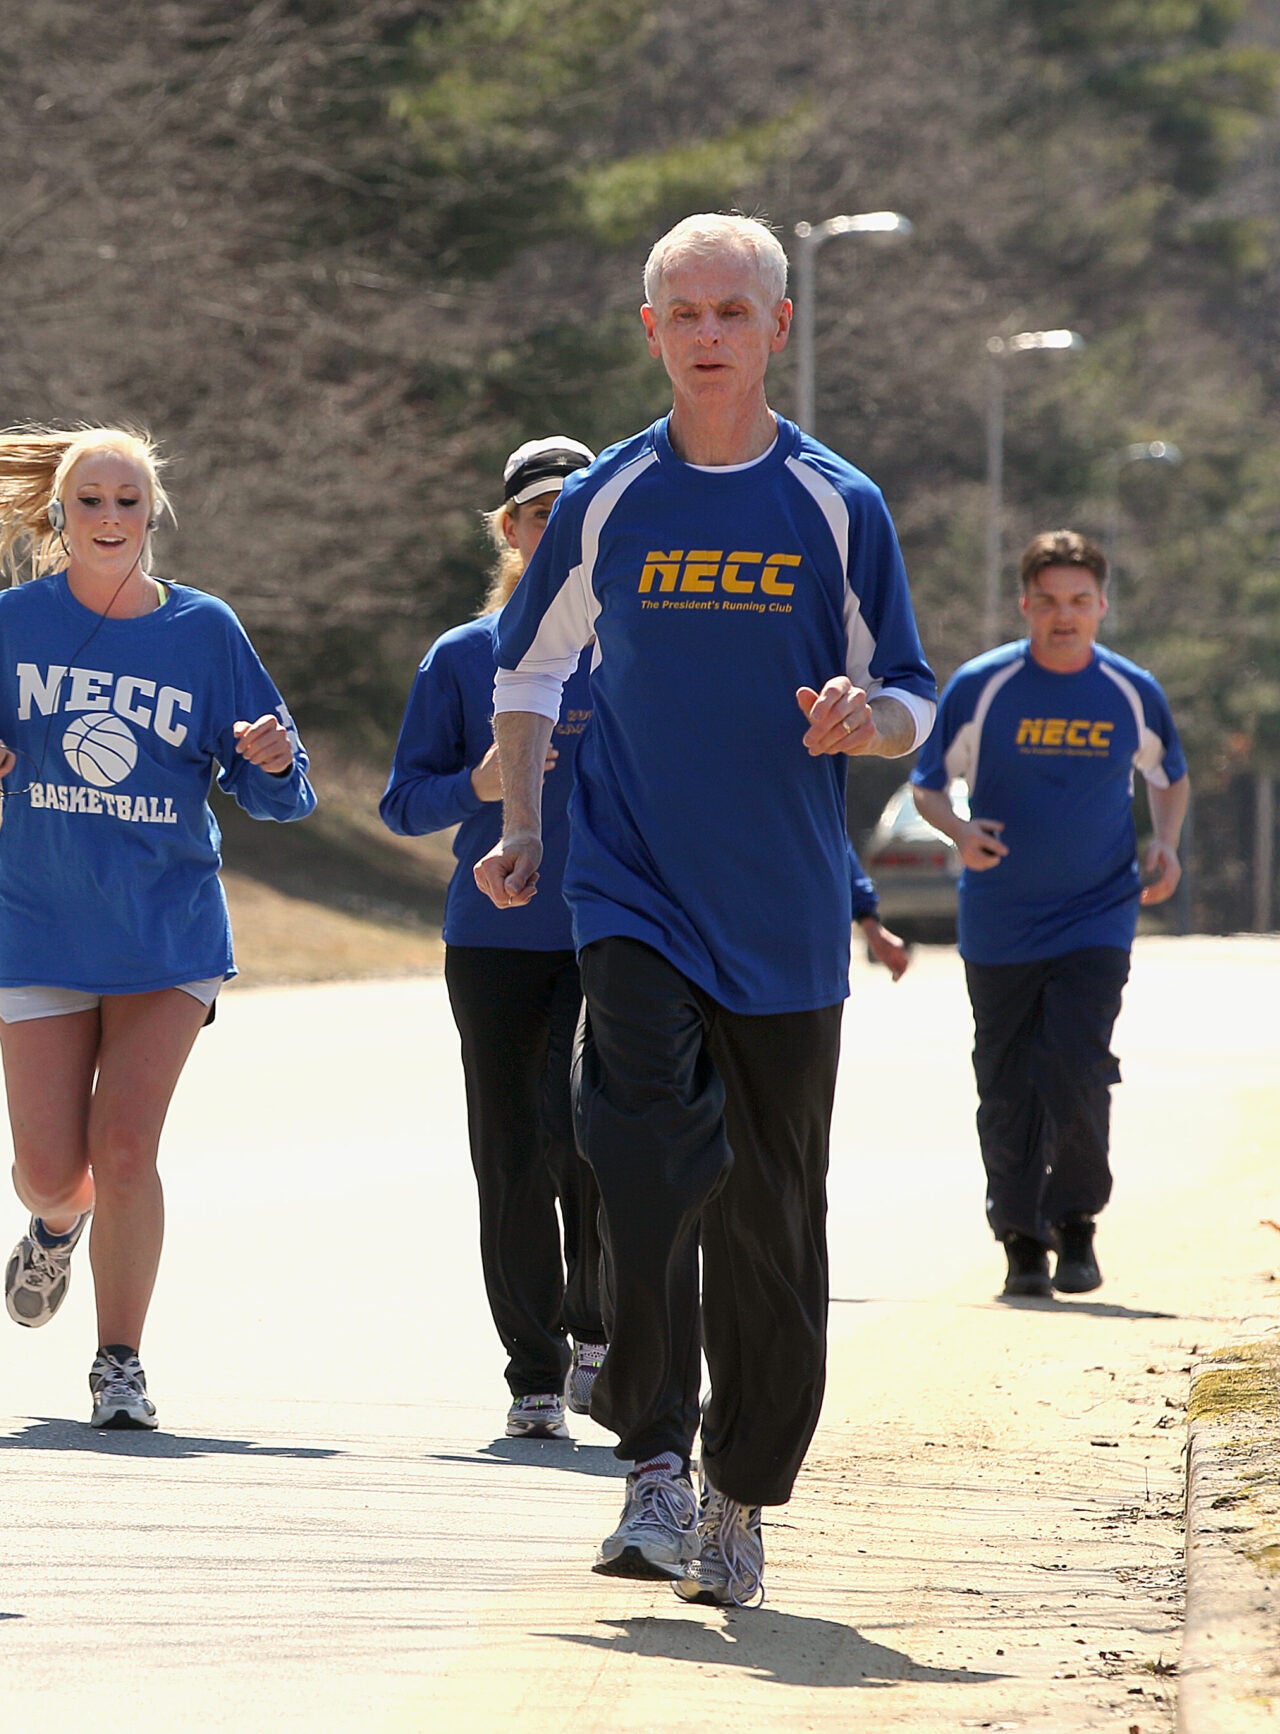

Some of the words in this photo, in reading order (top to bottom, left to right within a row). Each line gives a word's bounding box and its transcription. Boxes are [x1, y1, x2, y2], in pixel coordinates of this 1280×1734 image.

[637, 549, 802, 597] NECC
[640, 600, 660, 610] The
[662, 600, 720, 610] President's
[722, 601, 766, 614] Running
[768, 602, 793, 613] Club
[16, 662, 193, 748] NECC
[1015, 718, 1115, 748] NECC
[28, 781, 178, 824] BASKETBALL
